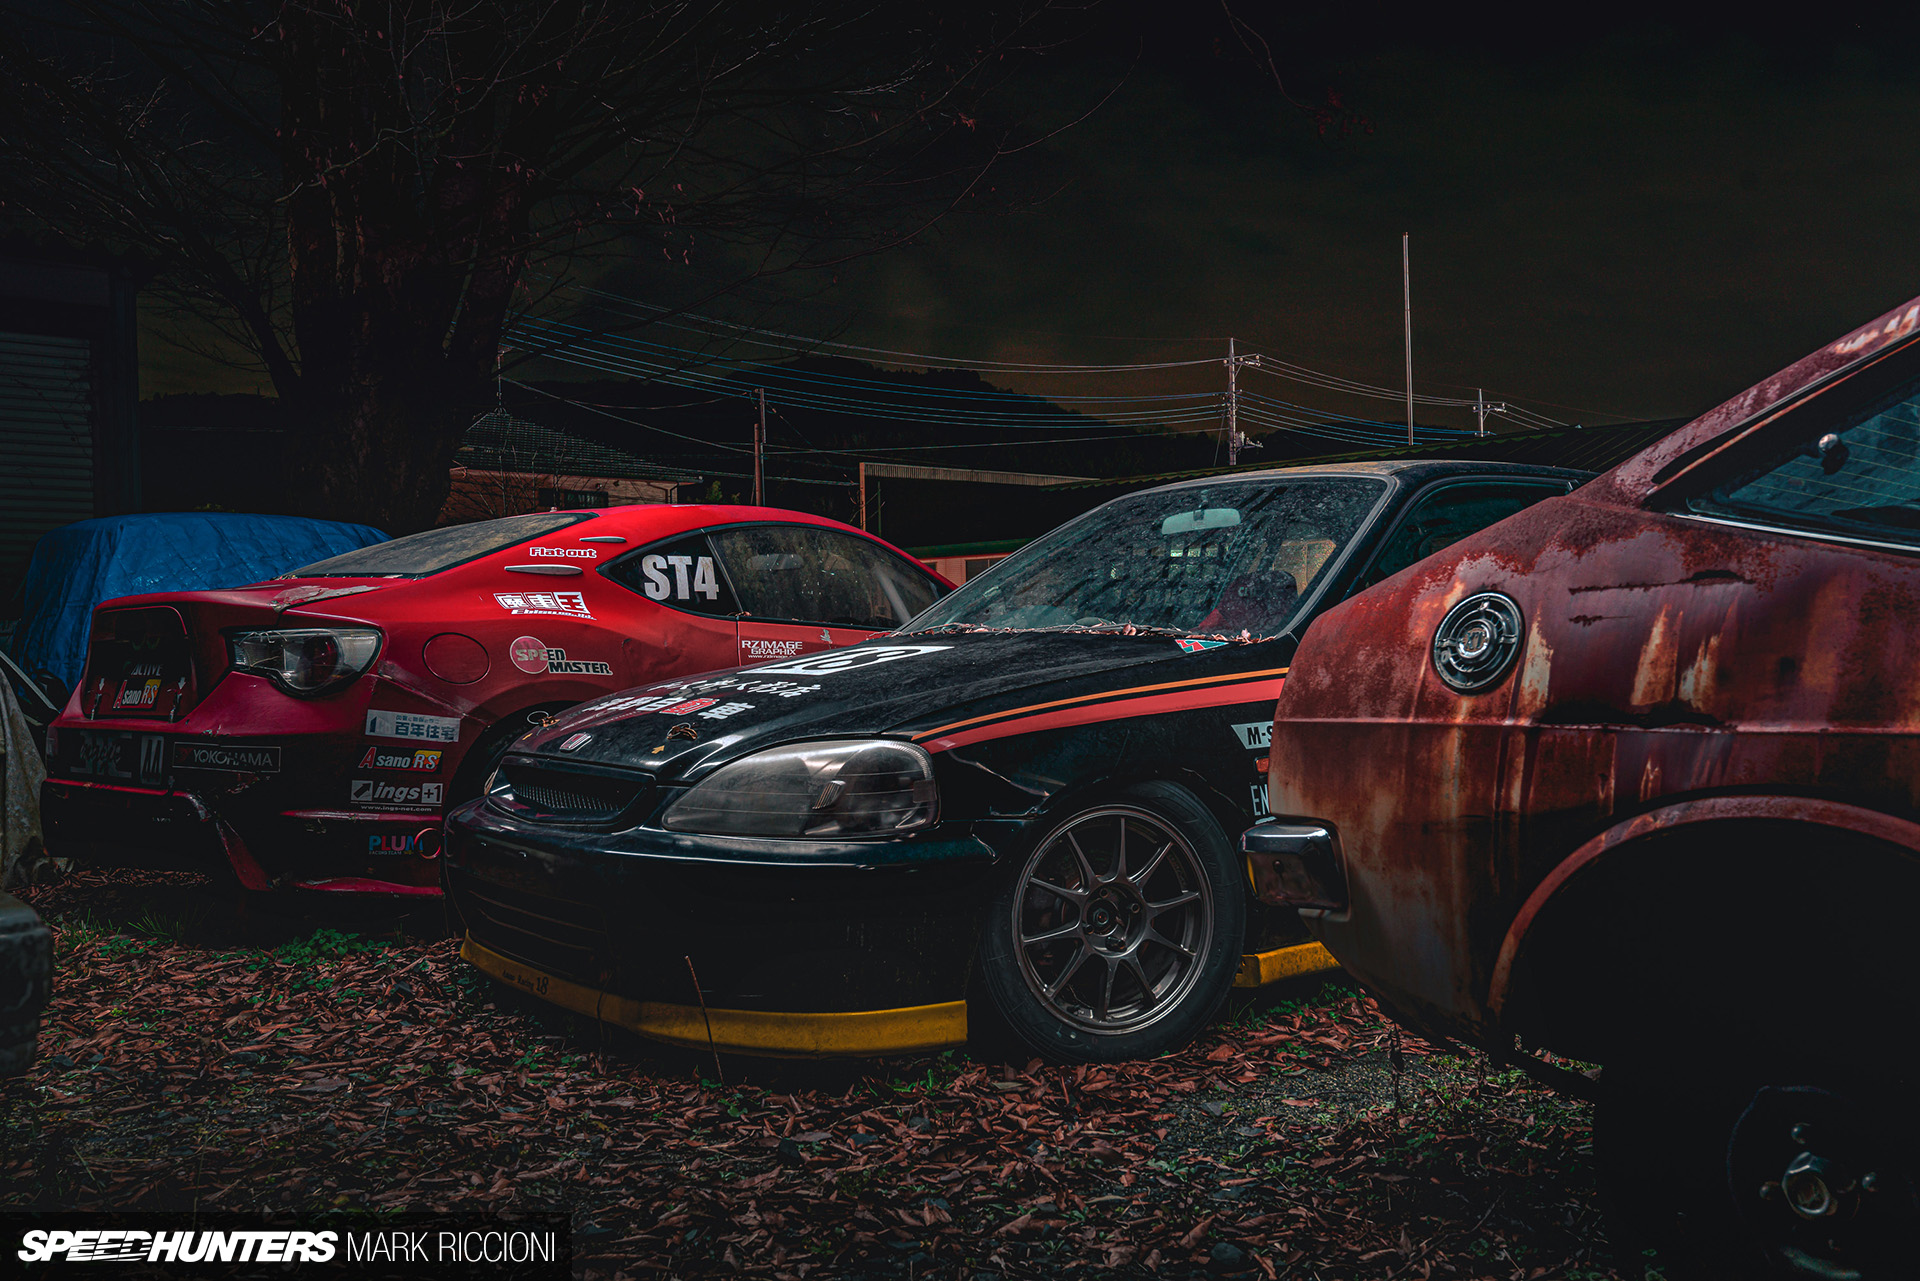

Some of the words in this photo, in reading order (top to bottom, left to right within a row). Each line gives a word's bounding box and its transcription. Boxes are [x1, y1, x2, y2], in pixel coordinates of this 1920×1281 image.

[530, 547, 564, 556] Flat
[566, 549, 597, 558] out
[642, 554, 719, 600] ST4
[515, 650, 565, 661] SPEED
[762, 648, 921, 670] 18
[549, 661, 612, 674] MASTER
[113, 680, 141, 708] Asano
[140, 685, 157, 704] RS
[395, 722, 455, 740] 百年住宅
[193, 749, 273, 766] YOKOHAMA
[358, 747, 411, 768] Asano
[413, 754, 438, 769] RS
[374, 782, 420, 802] ings
[369, 835, 423, 850] PLUM
[536, 976, 549, 995] 18
